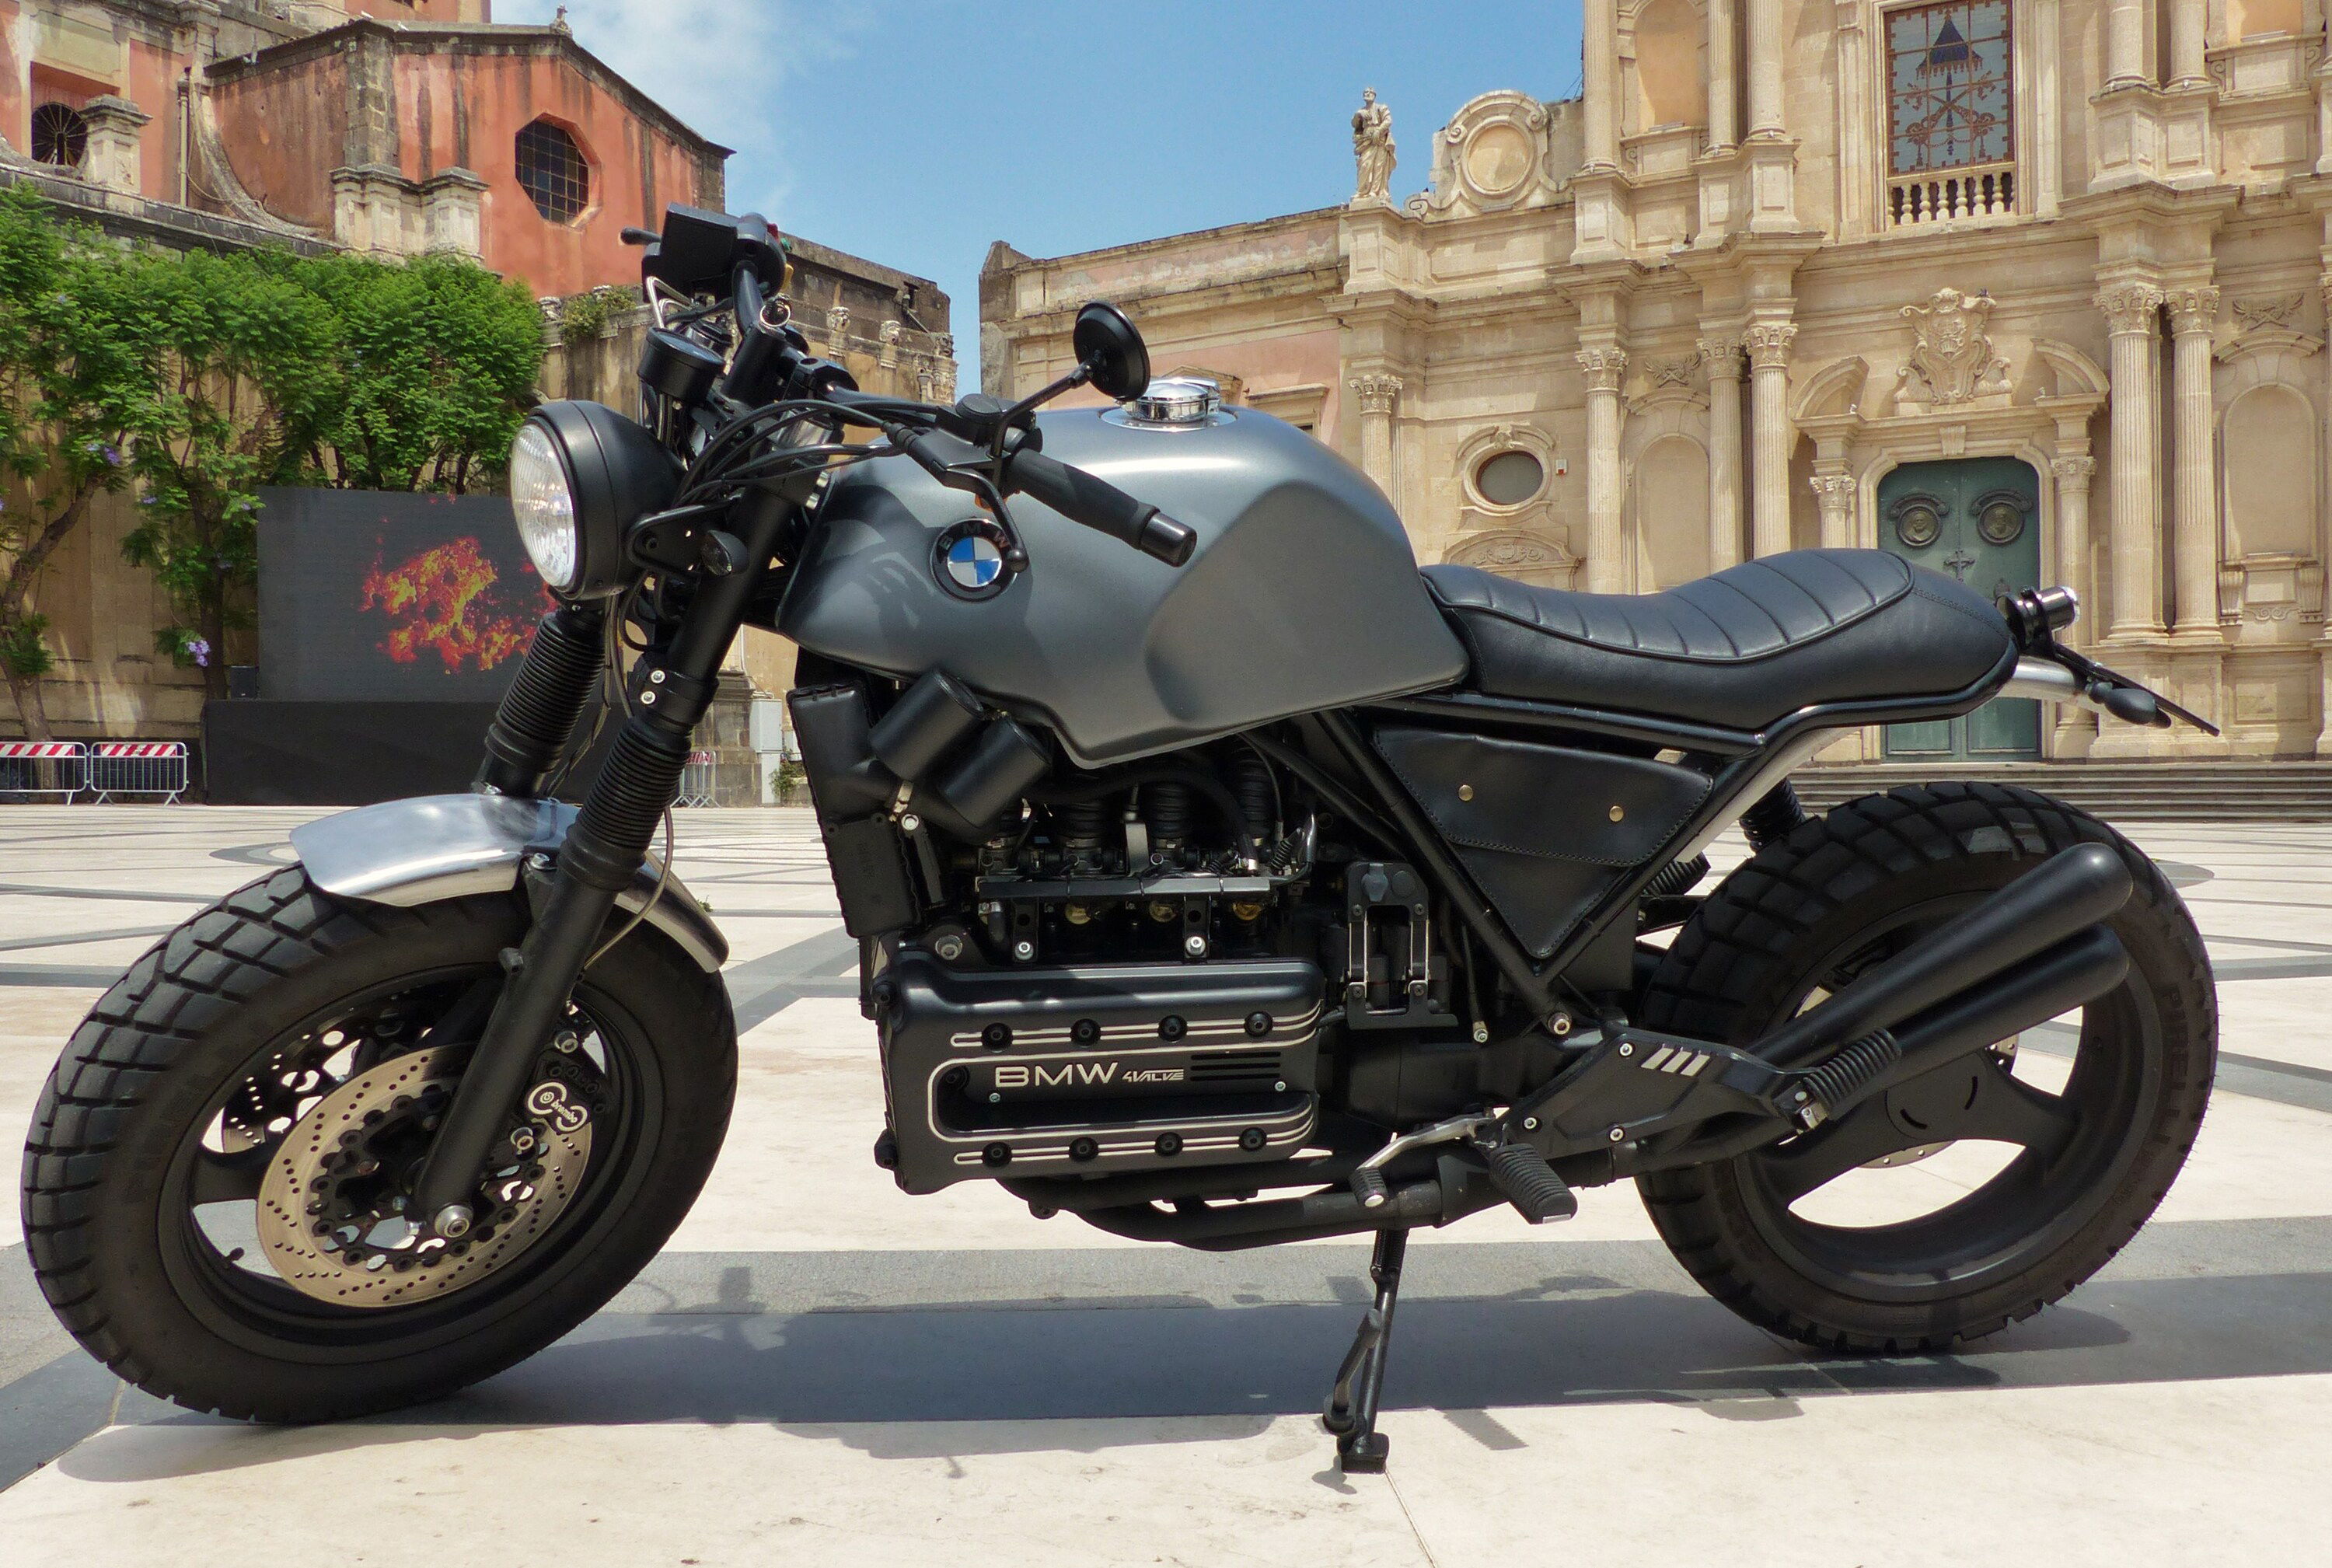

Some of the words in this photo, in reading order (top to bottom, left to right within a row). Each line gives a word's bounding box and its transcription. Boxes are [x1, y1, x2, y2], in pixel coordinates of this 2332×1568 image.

[939, 522, 1011, 550] BMW
[995, 1062, 1118, 1087] BMW
[550, 1098, 578, 1123] brembo
